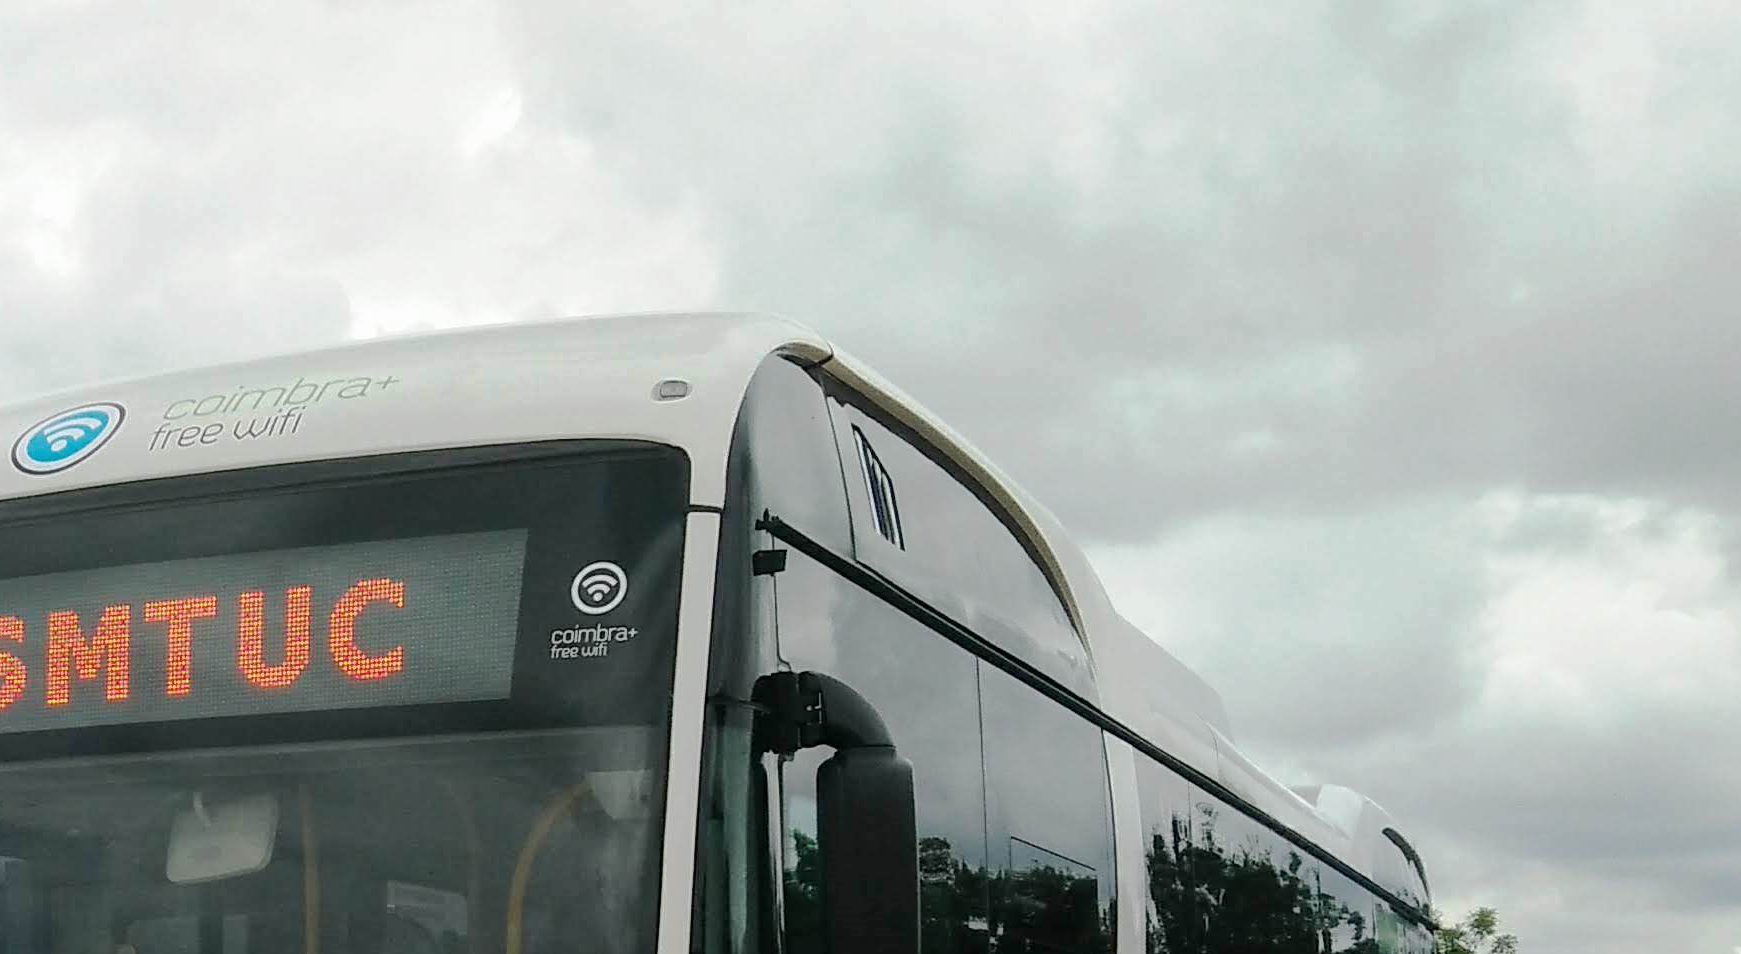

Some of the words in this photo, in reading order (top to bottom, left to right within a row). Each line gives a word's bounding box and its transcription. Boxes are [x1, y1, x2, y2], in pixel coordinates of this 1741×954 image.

[162, 375, 400, 421] coimbra+
[149, 422, 224, 451] free
[233, 405, 307, 441] wifi
[550, 645, 579, 659] free
[581, 642, 608, 657] wifi
[551, 623, 639, 645] coimbra+
